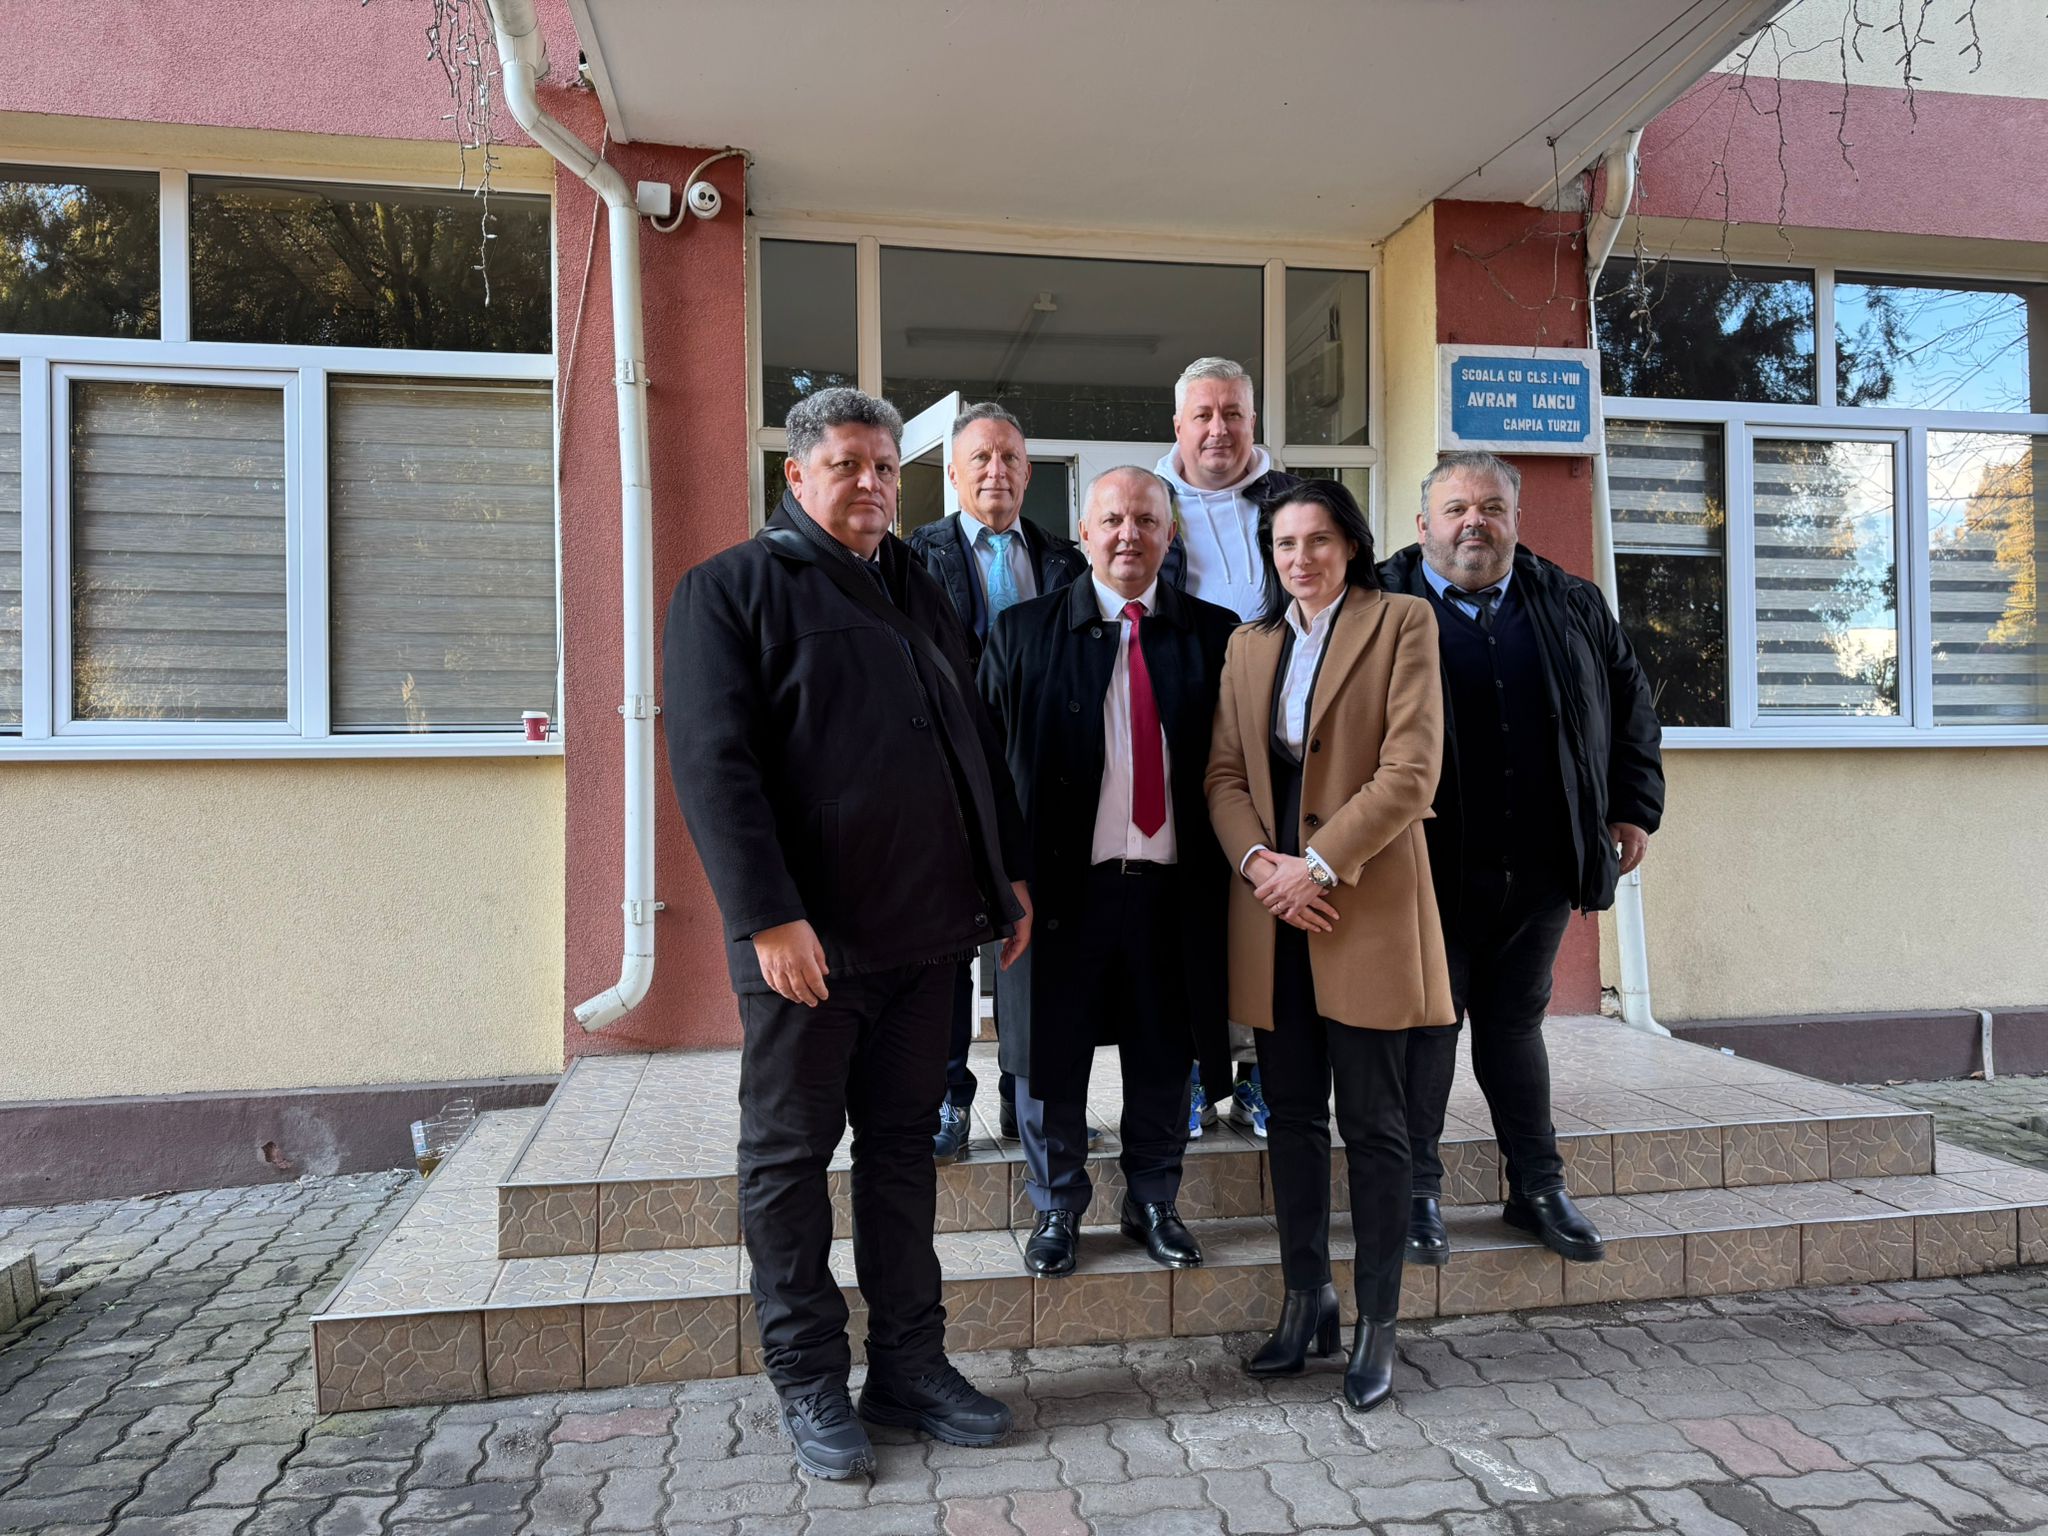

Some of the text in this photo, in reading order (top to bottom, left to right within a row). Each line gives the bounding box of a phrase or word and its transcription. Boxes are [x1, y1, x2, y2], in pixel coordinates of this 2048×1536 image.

[1461, 368, 1505, 382] SCOALA
[1503, 418, 1580, 433] CAMPIA TURZII
